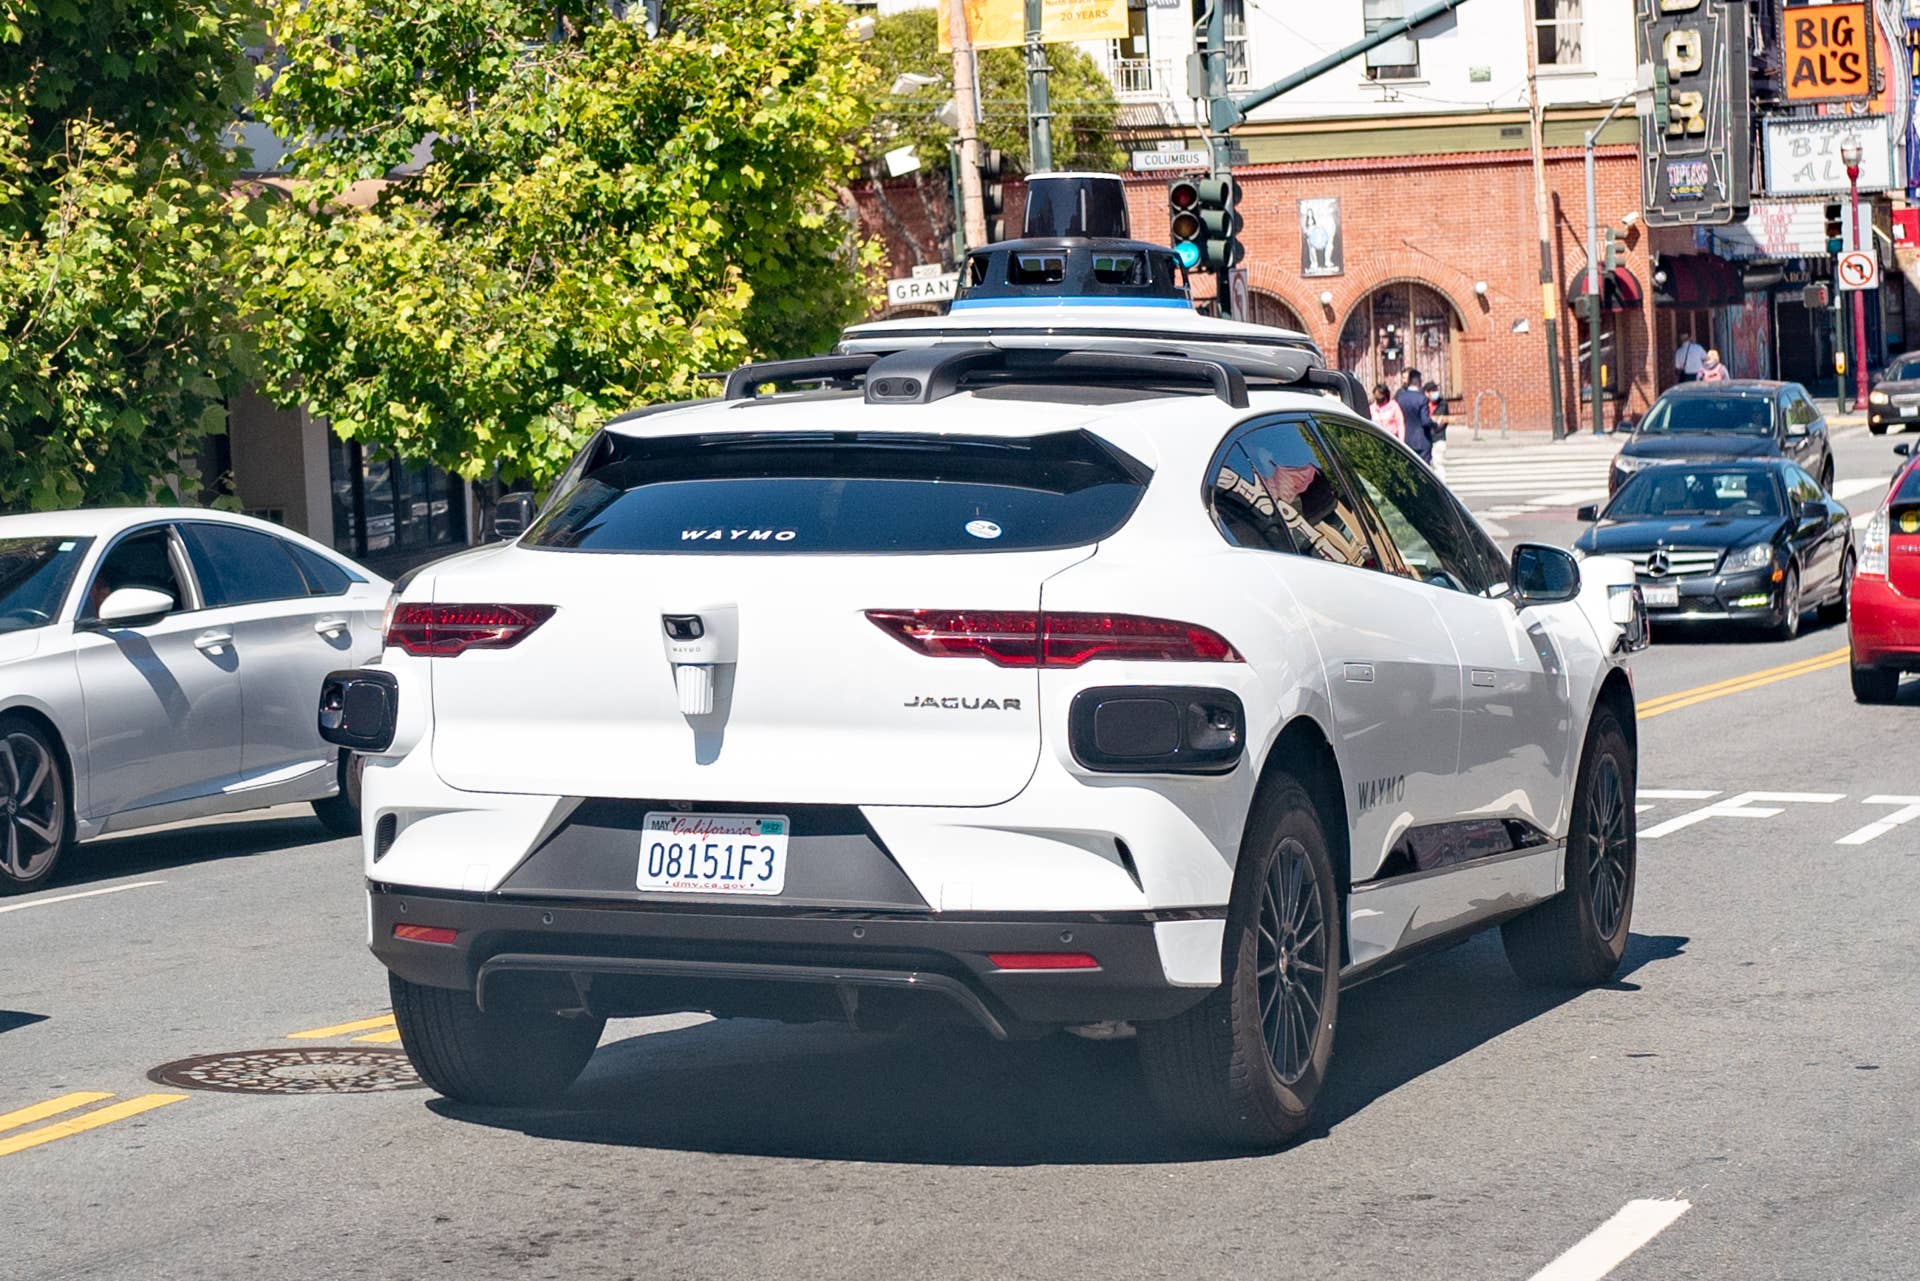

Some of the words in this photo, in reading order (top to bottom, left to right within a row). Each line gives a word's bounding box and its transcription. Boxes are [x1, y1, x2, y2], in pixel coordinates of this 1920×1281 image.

[1076, 10, 1109, 20] YEARS
[1796, 16, 1855, 49] BIG
[1792, 51, 1862, 88] AL'S
[1144, 153, 1200, 166] COLUMBUS
[681, 530, 796, 541] WAYMO
[904, 696, 1021, 710] JAGUAR
[1358, 775, 1405, 809] WAYMO
[651, 821, 671, 830] MAY
[672, 817, 761, 841] California
[648, 842, 775, 881] 08151F3
[672, 880, 746, 889] dmv.ca.gov
